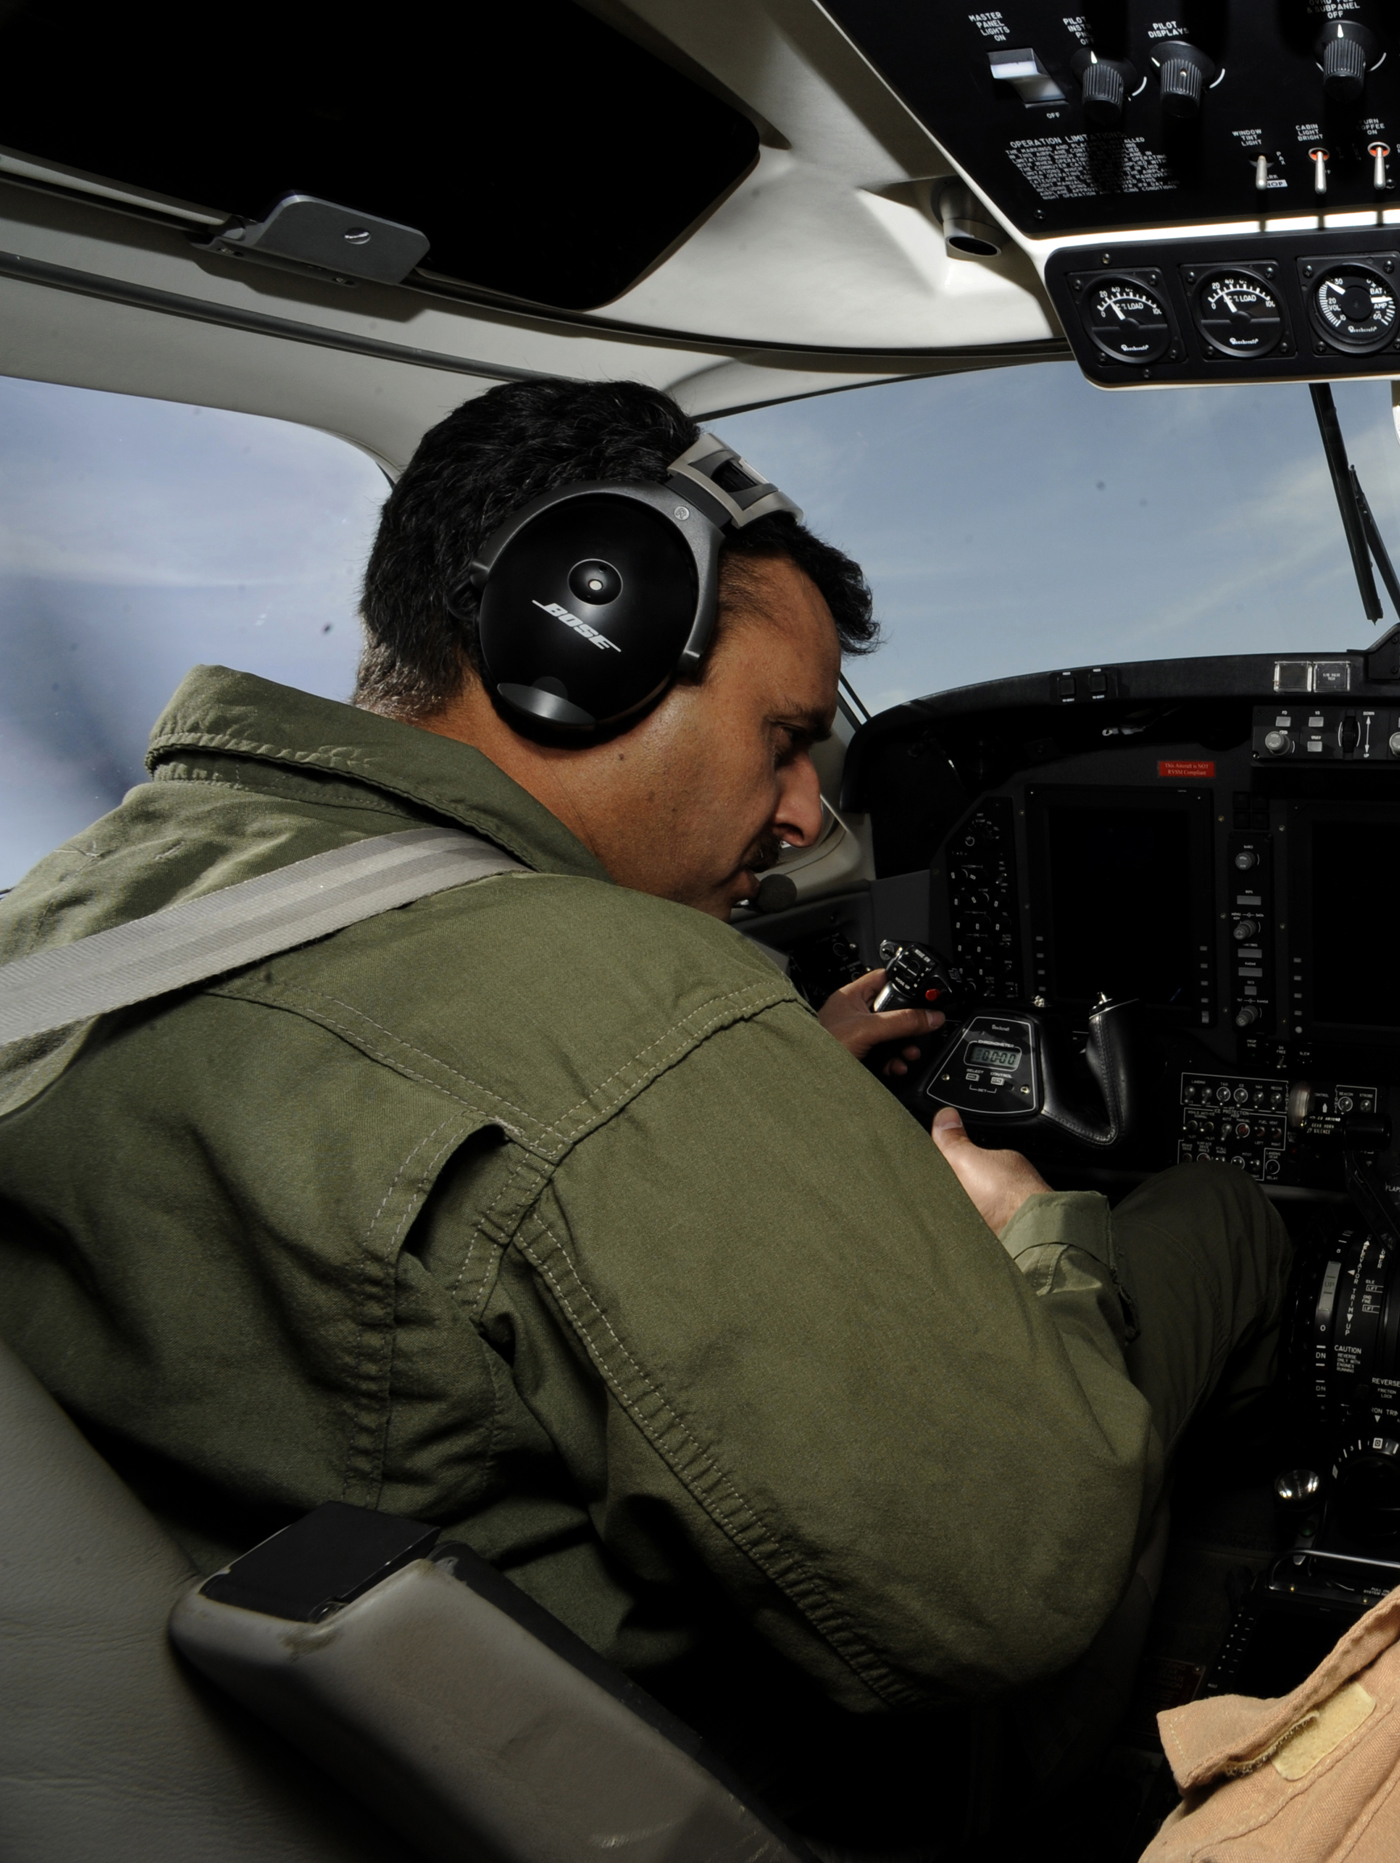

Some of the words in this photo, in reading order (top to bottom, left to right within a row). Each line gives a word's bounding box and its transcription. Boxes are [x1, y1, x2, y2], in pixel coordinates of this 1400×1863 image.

[1315, 2, 1360, 12] SUBPANEL
[968, 11, 1002, 22] MASTER
[1327, 11, 1343, 19] OFF
[976, 20, 1004, 29] PANEL
[1063, 16, 1087, 26] PILOT
[1152, 21, 1177, 30] PILOT
[980, 26, 1010, 36] LIGHTS
[1147, 28, 1189, 38] DISPLAYS
[994, 34, 1006, 42] ON
[1046, 112, 1060, 120] OFF
[1010, 137, 1062, 148] OPERATION
[1276, 152, 1286, 165] PAX
[1212, 282, 1220, 290] 20
[1099, 290, 1108, 298] 20
[1239, 294, 1257, 302] LOAD
[1127, 302, 1144, 310] LOAD
[1211, 302, 1216, 310] 0
[531, 599, 622, 652] BOSE
[1348, 1288, 1356, 1313] TRIM
[1344, 1323, 1351, 1336] UP
[1334, 1344, 1362, 1355] CAUTION
[1372, 1377, 1400, 1388] REVERSE
